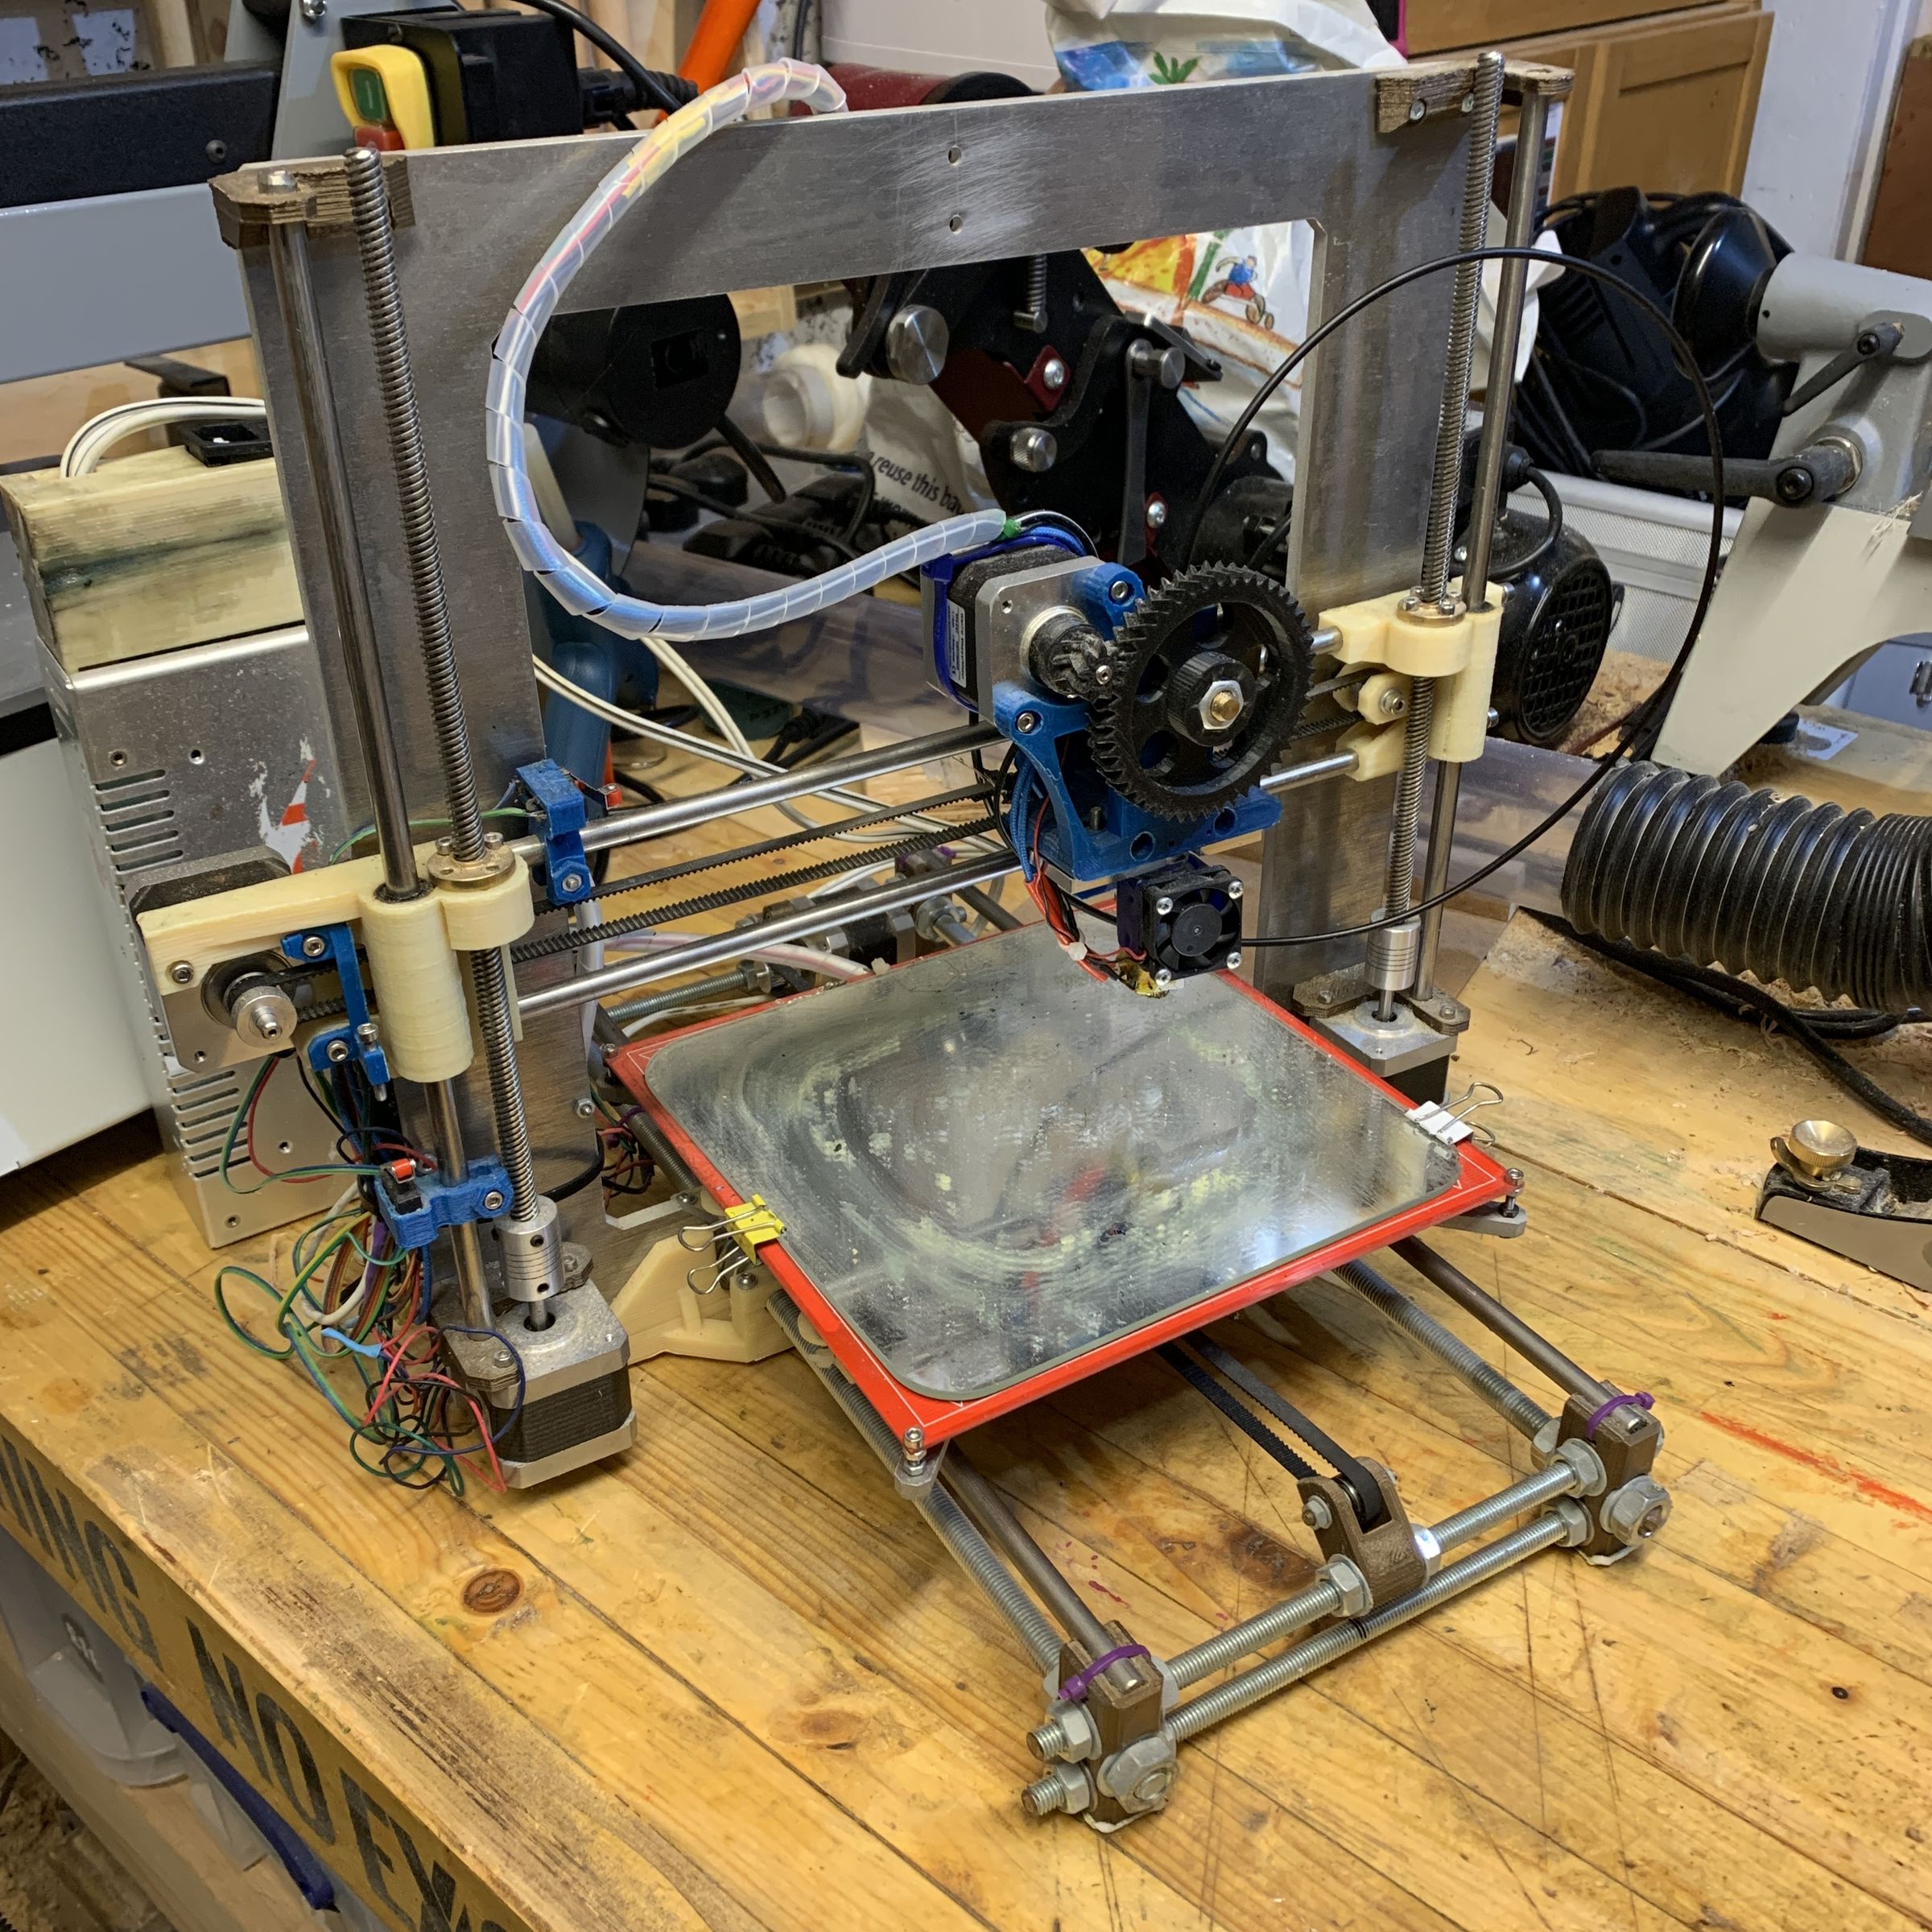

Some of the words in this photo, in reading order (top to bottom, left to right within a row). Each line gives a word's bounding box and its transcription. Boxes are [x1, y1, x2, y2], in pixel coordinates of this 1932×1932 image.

[873, 456, 912, 486] reuse
[911, 472, 940, 502] this
[185, 1616, 336, 1846] NO
